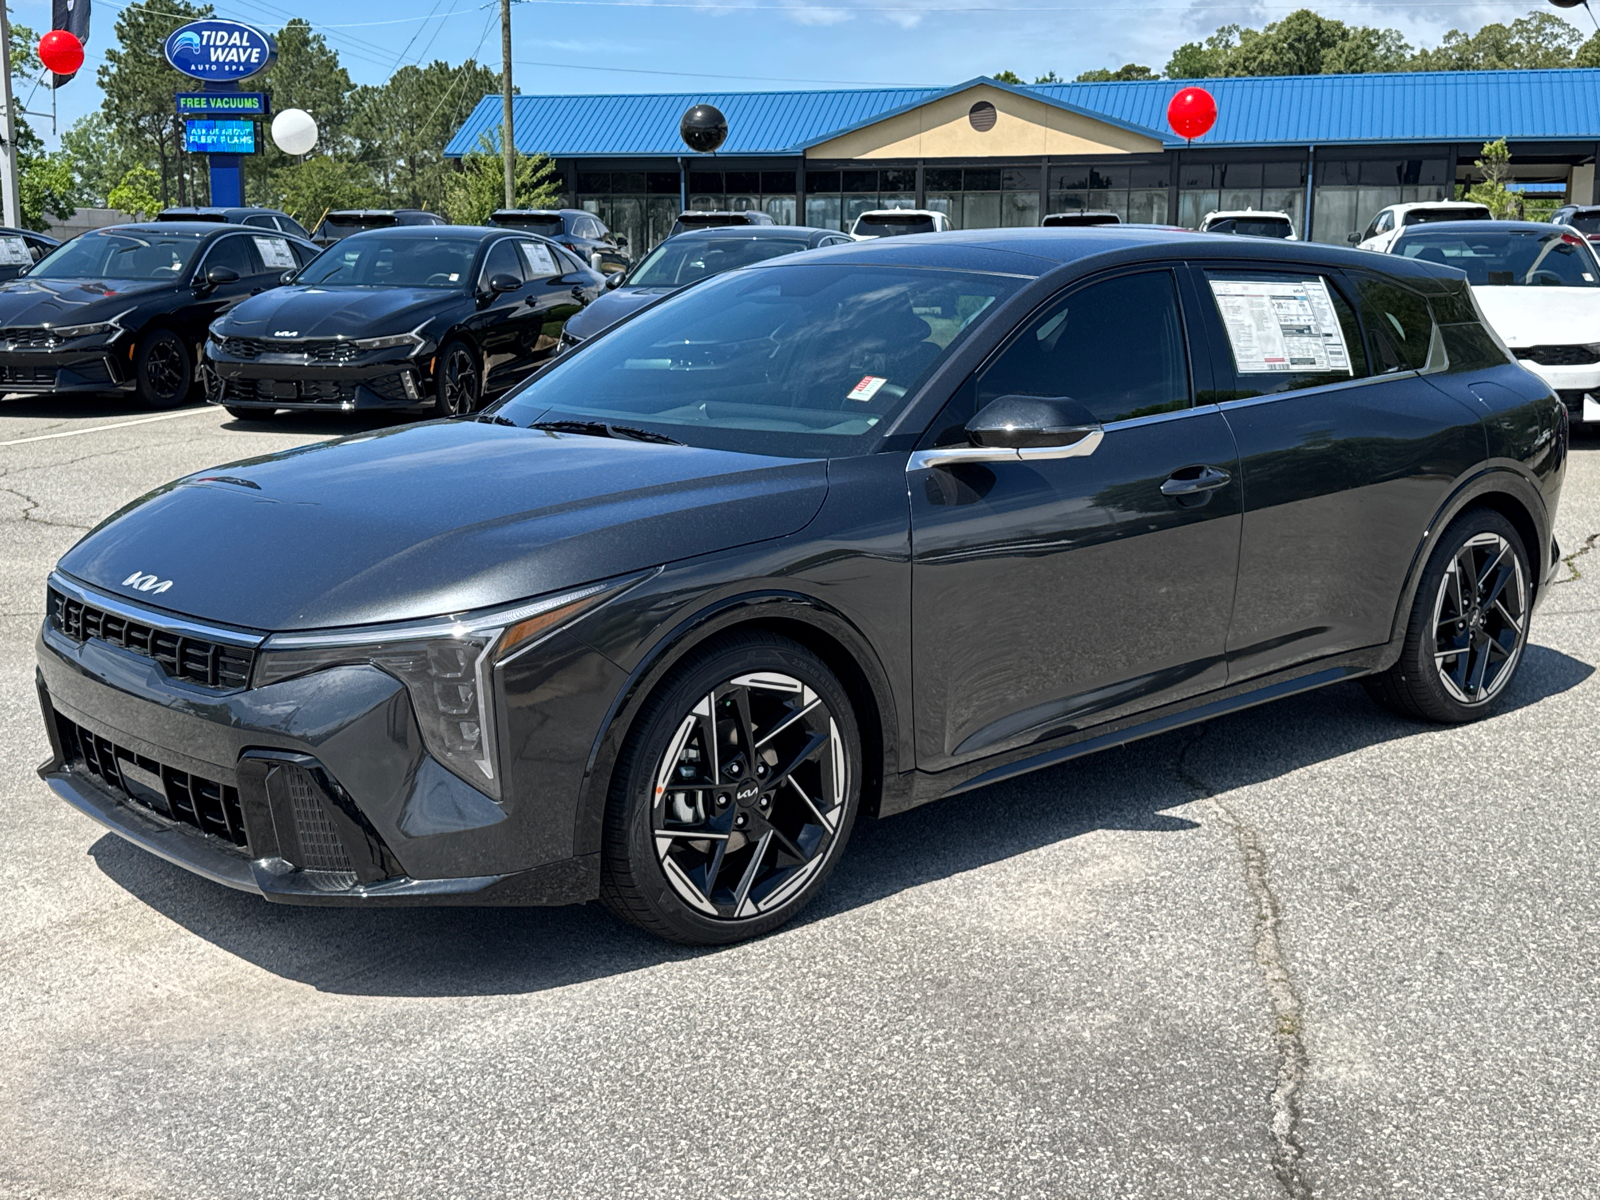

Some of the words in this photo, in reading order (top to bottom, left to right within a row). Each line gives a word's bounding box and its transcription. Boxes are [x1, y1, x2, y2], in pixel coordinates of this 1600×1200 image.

[201, 31, 250, 46] TIDAL
[209, 48, 261, 63] WAVE
[180, 98, 208, 108] FREE
[209, 98, 259, 108] VACUUMS
[121, 570, 173, 595] KIA
[736, 786, 759, 800] KIA
